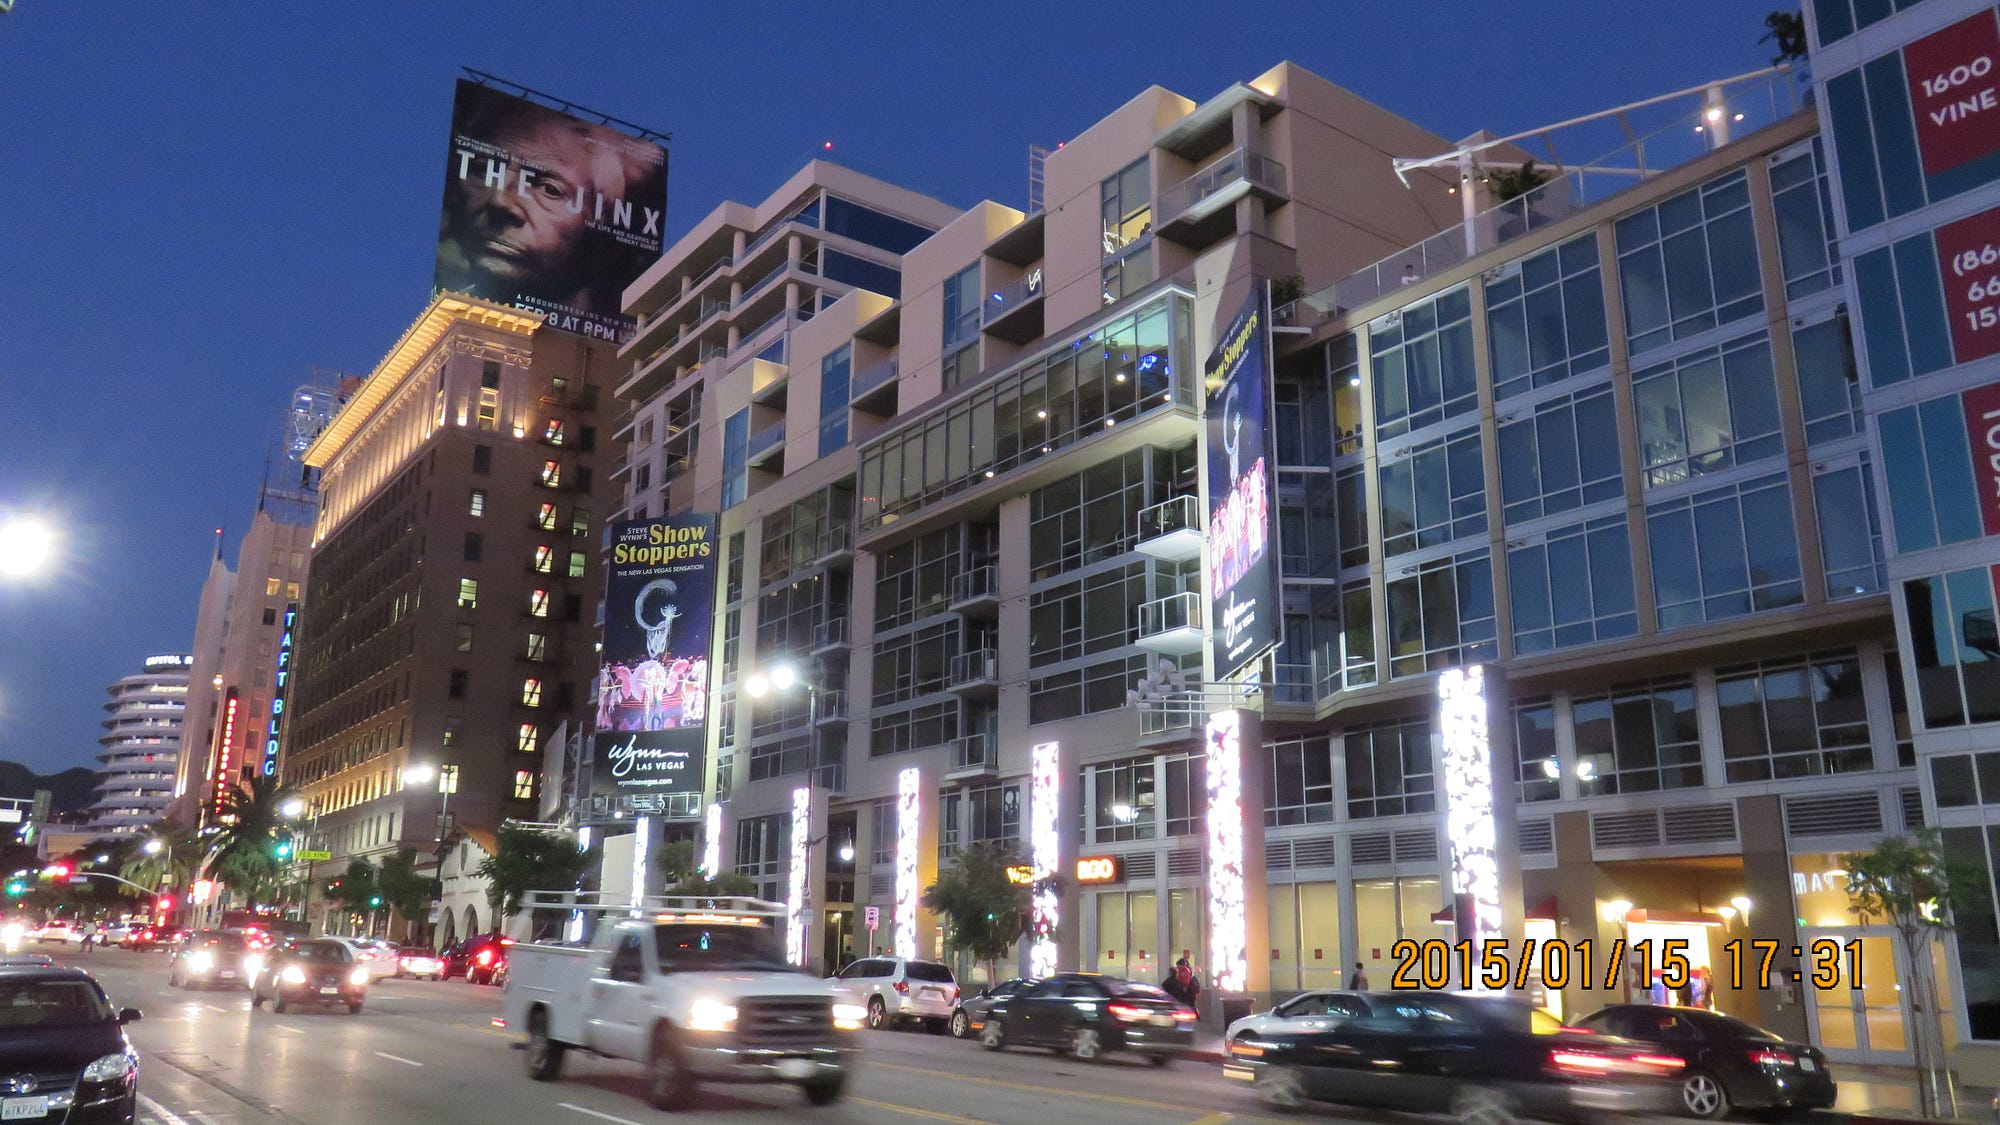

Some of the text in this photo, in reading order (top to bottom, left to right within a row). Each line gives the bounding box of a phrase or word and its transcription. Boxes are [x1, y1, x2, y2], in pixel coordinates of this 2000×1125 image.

[1922, 56, 1992, 97] 1600
[1930, 87, 1998, 126] VINE
[456, 149, 536, 200] THE
[565, 186, 660, 237] JINX
[598, 224, 611, 233] LIFE
[1953, 244, 2000, 276] (86
[525, 295, 600, 321] GROUNDBREAKING
[603, 316, 620, 326] NEW
[548, 311, 559, 326] 8
[562, 315, 580, 332] AT
[1966, 306, 2000, 331] 15
[1224, 310, 1258, 371] Stoppers
[620, 533, 647, 542] WYNN'S
[627, 526, 648, 535] STEVE
[649, 523, 708, 545] Show
[614, 541, 711, 566] Stoppers
[628, 568, 641, 577] NEW
[642, 567, 653, 575] LAS
[653, 565, 672, 574] VEGAS
[673, 563, 705, 573] SENSATION
[145, 655, 182, 666] CAPITOL
[265, 612, 295, 776] TAFT BLDG
[636, 761, 684, 771] LAS VEGAS
[617, 778, 673, 787] wynnlasvegas.com
